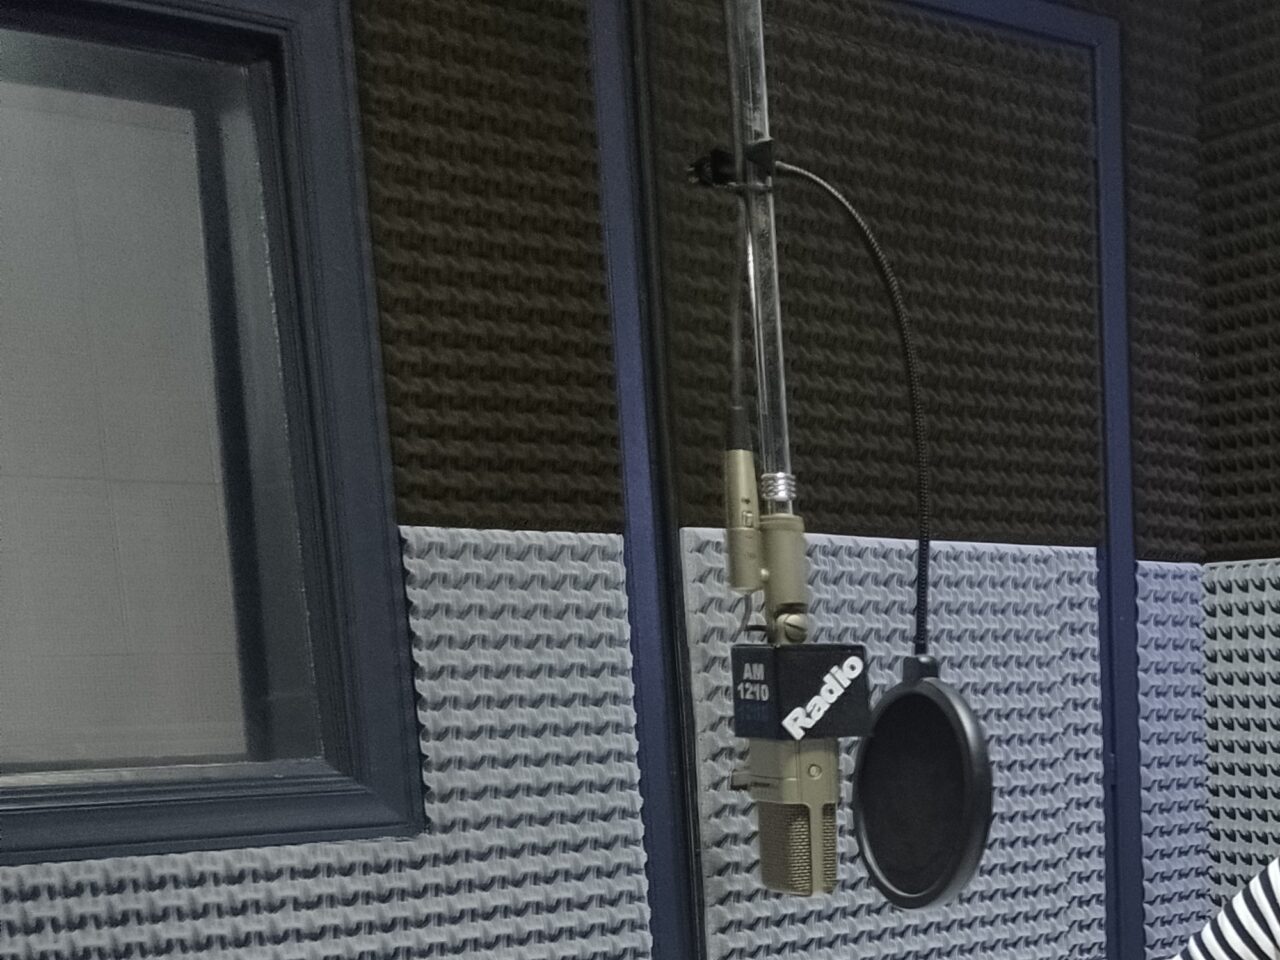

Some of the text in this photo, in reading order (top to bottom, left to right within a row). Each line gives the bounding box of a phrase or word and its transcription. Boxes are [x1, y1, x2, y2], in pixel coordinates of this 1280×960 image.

[743, 663, 765, 681] AM
[737, 682, 769, 701] 1210
[781, 655, 864, 740] Radio
